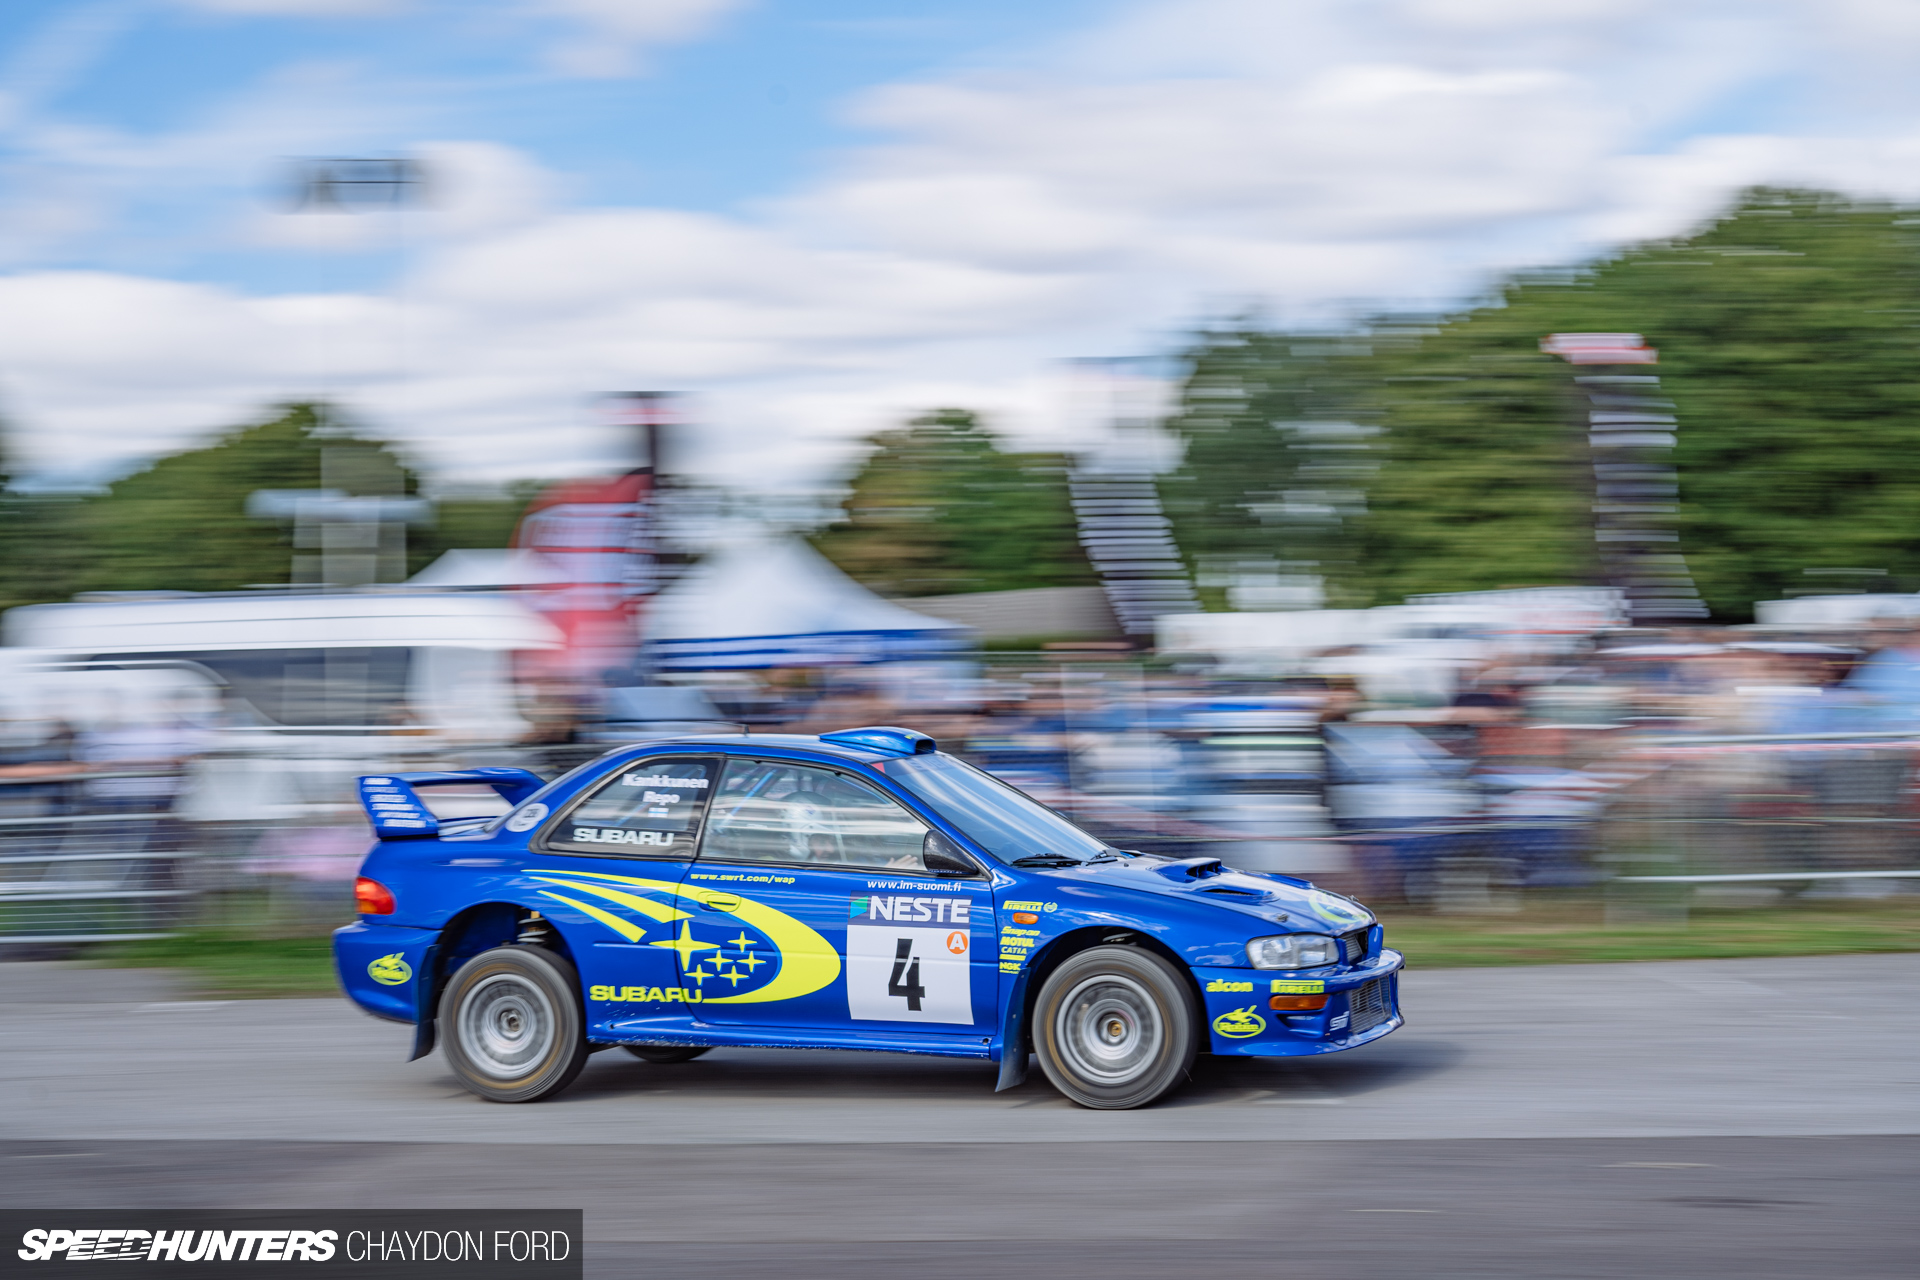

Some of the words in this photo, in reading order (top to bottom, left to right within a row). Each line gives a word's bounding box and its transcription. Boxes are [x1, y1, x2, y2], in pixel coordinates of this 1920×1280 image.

[621, 773, 709, 789] Kankkunen
[642, 791, 680, 805] Repo
[573, 828, 675, 846] SUBARU
[690, 873, 796, 885] www.swrt.com/wap
[867, 880, 962, 892] www.im-suomi.fi
[869, 895, 972, 924] NESTE
[1002, 900, 1043, 911] PIRELLI
[949, 933, 966, 951] A
[1000, 936, 1035, 947] MOTUL
[1001, 946, 1028, 955] CATIA
[999, 961, 1022, 971] NGK
[888, 937, 926, 1012] 4
[1206, 979, 1254, 992] alcon
[1270, 979, 1325, 994] PIRELLI
[589, 985, 702, 1004] SUBARU
